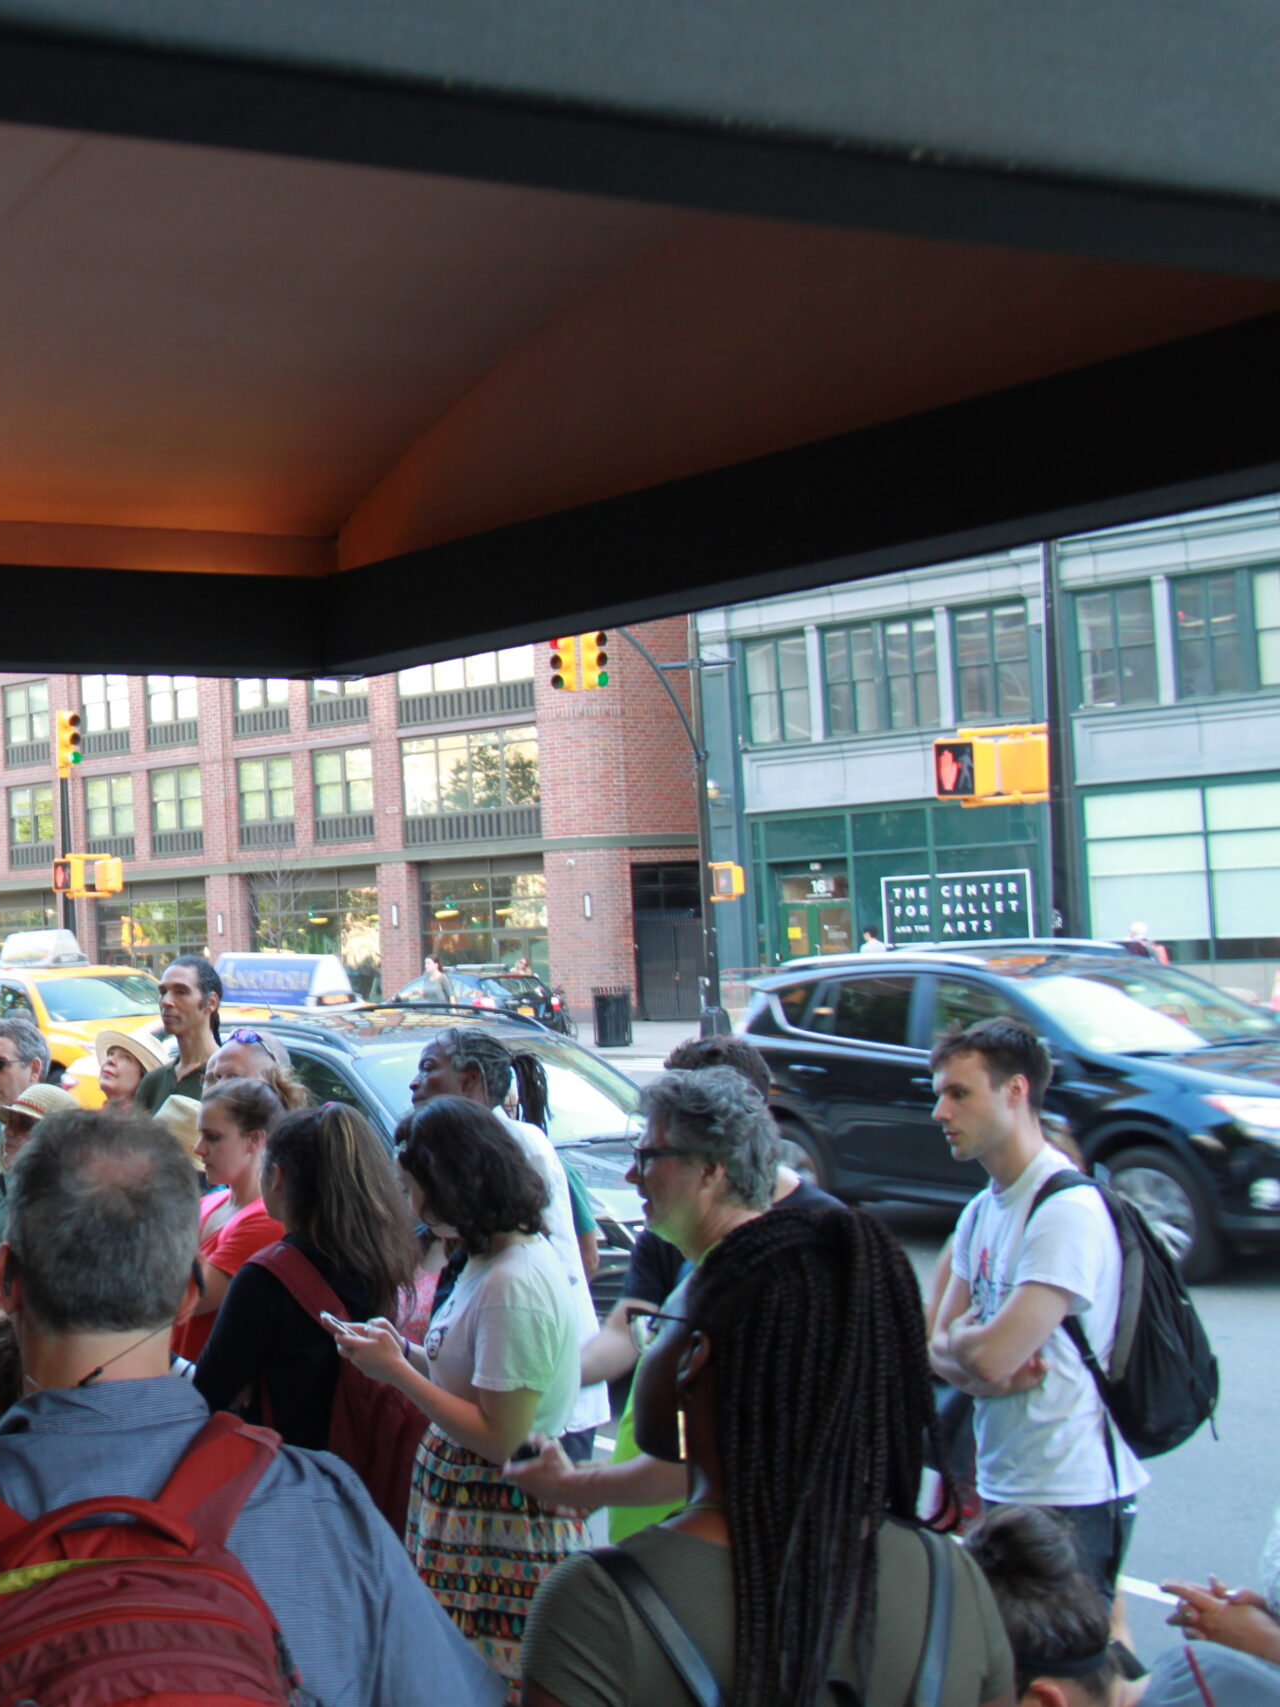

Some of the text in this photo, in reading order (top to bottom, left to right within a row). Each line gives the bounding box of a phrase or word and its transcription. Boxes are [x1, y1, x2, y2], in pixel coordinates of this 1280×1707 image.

[810, 879, 827, 893] 16
[892, 881, 1018, 900] THE CENTER
[893, 899, 1019, 918] FOR BALLET
[894, 919, 993, 934] AND THE ARTS
